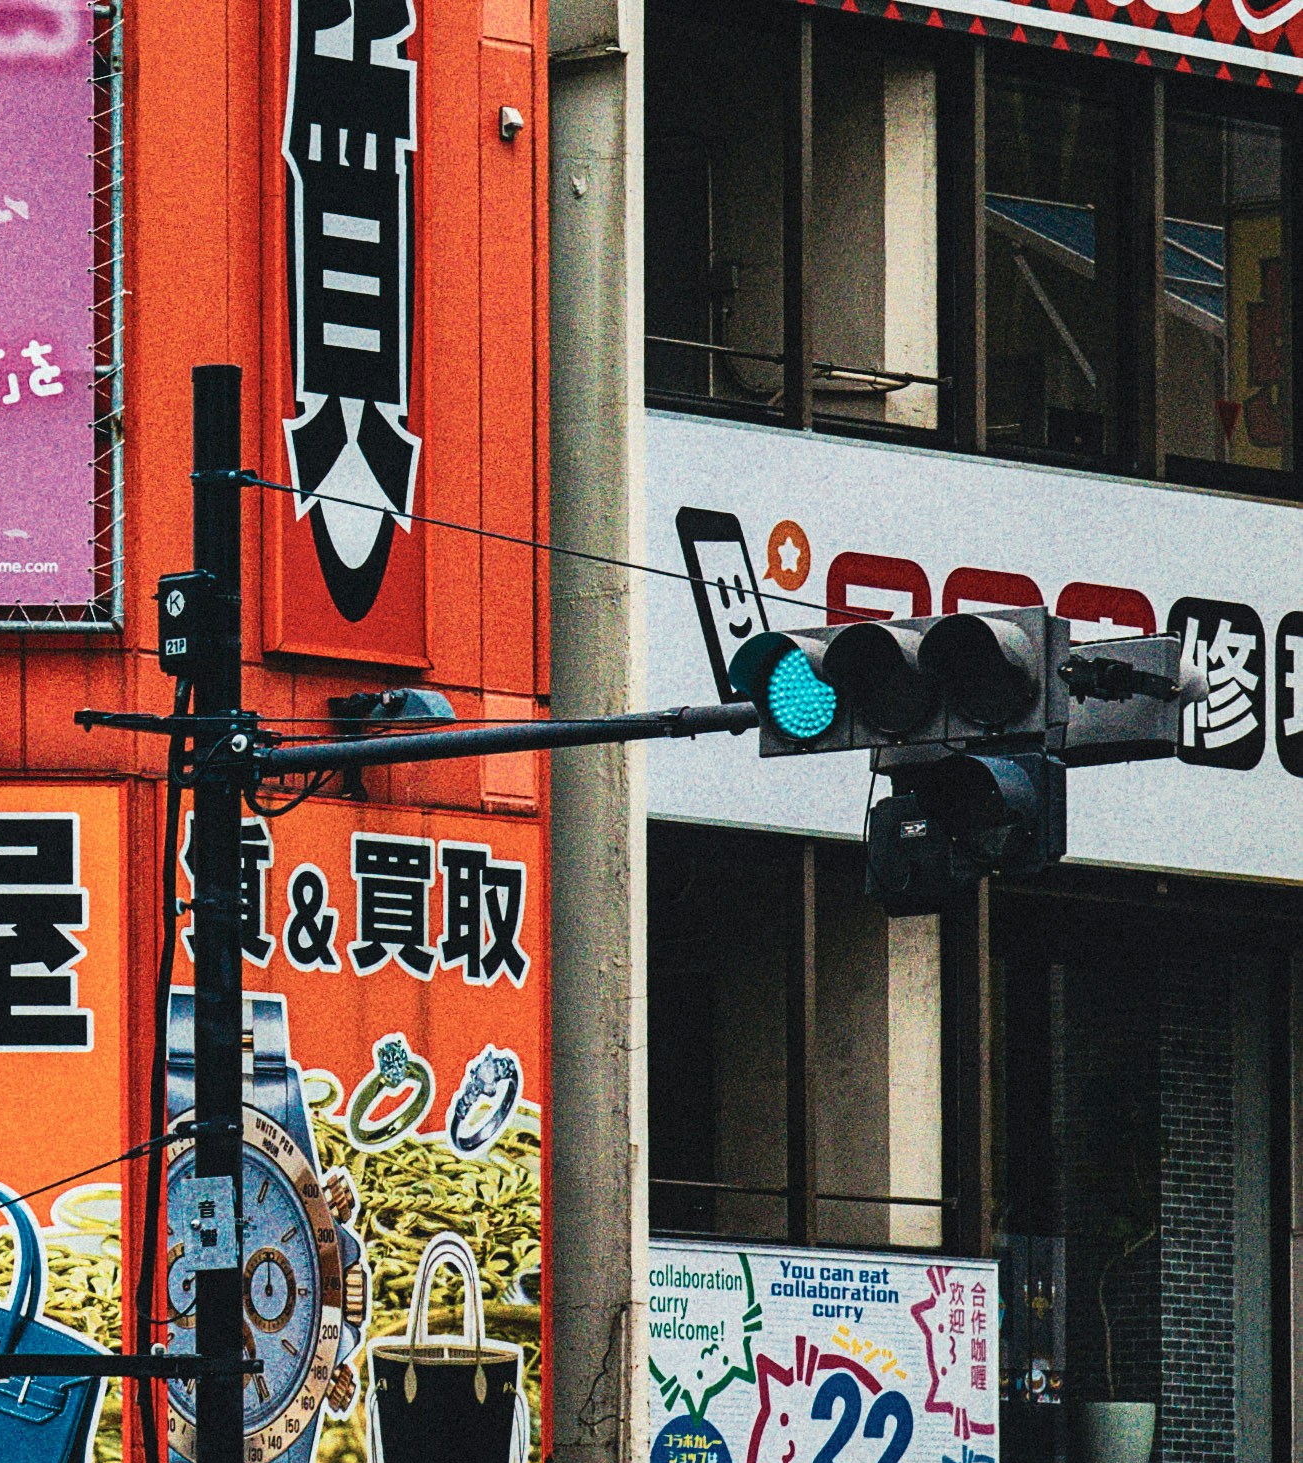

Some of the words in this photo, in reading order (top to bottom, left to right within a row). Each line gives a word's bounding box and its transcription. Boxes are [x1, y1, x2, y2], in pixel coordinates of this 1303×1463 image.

[649, 1267, 743, 1292] collaboration
[779, 1260, 815, 1282] You
[819, 1267, 852, 1283] can
[858, 1267, 890, 1286] eat
[770, 1281, 900, 1305] collaboration
[649, 1295, 689, 1317] curry
[811, 1302, 864, 1324] curry
[649, 1320, 725, 1343] welcome!
[662, 1433, 723, 1450] コラボカレー
